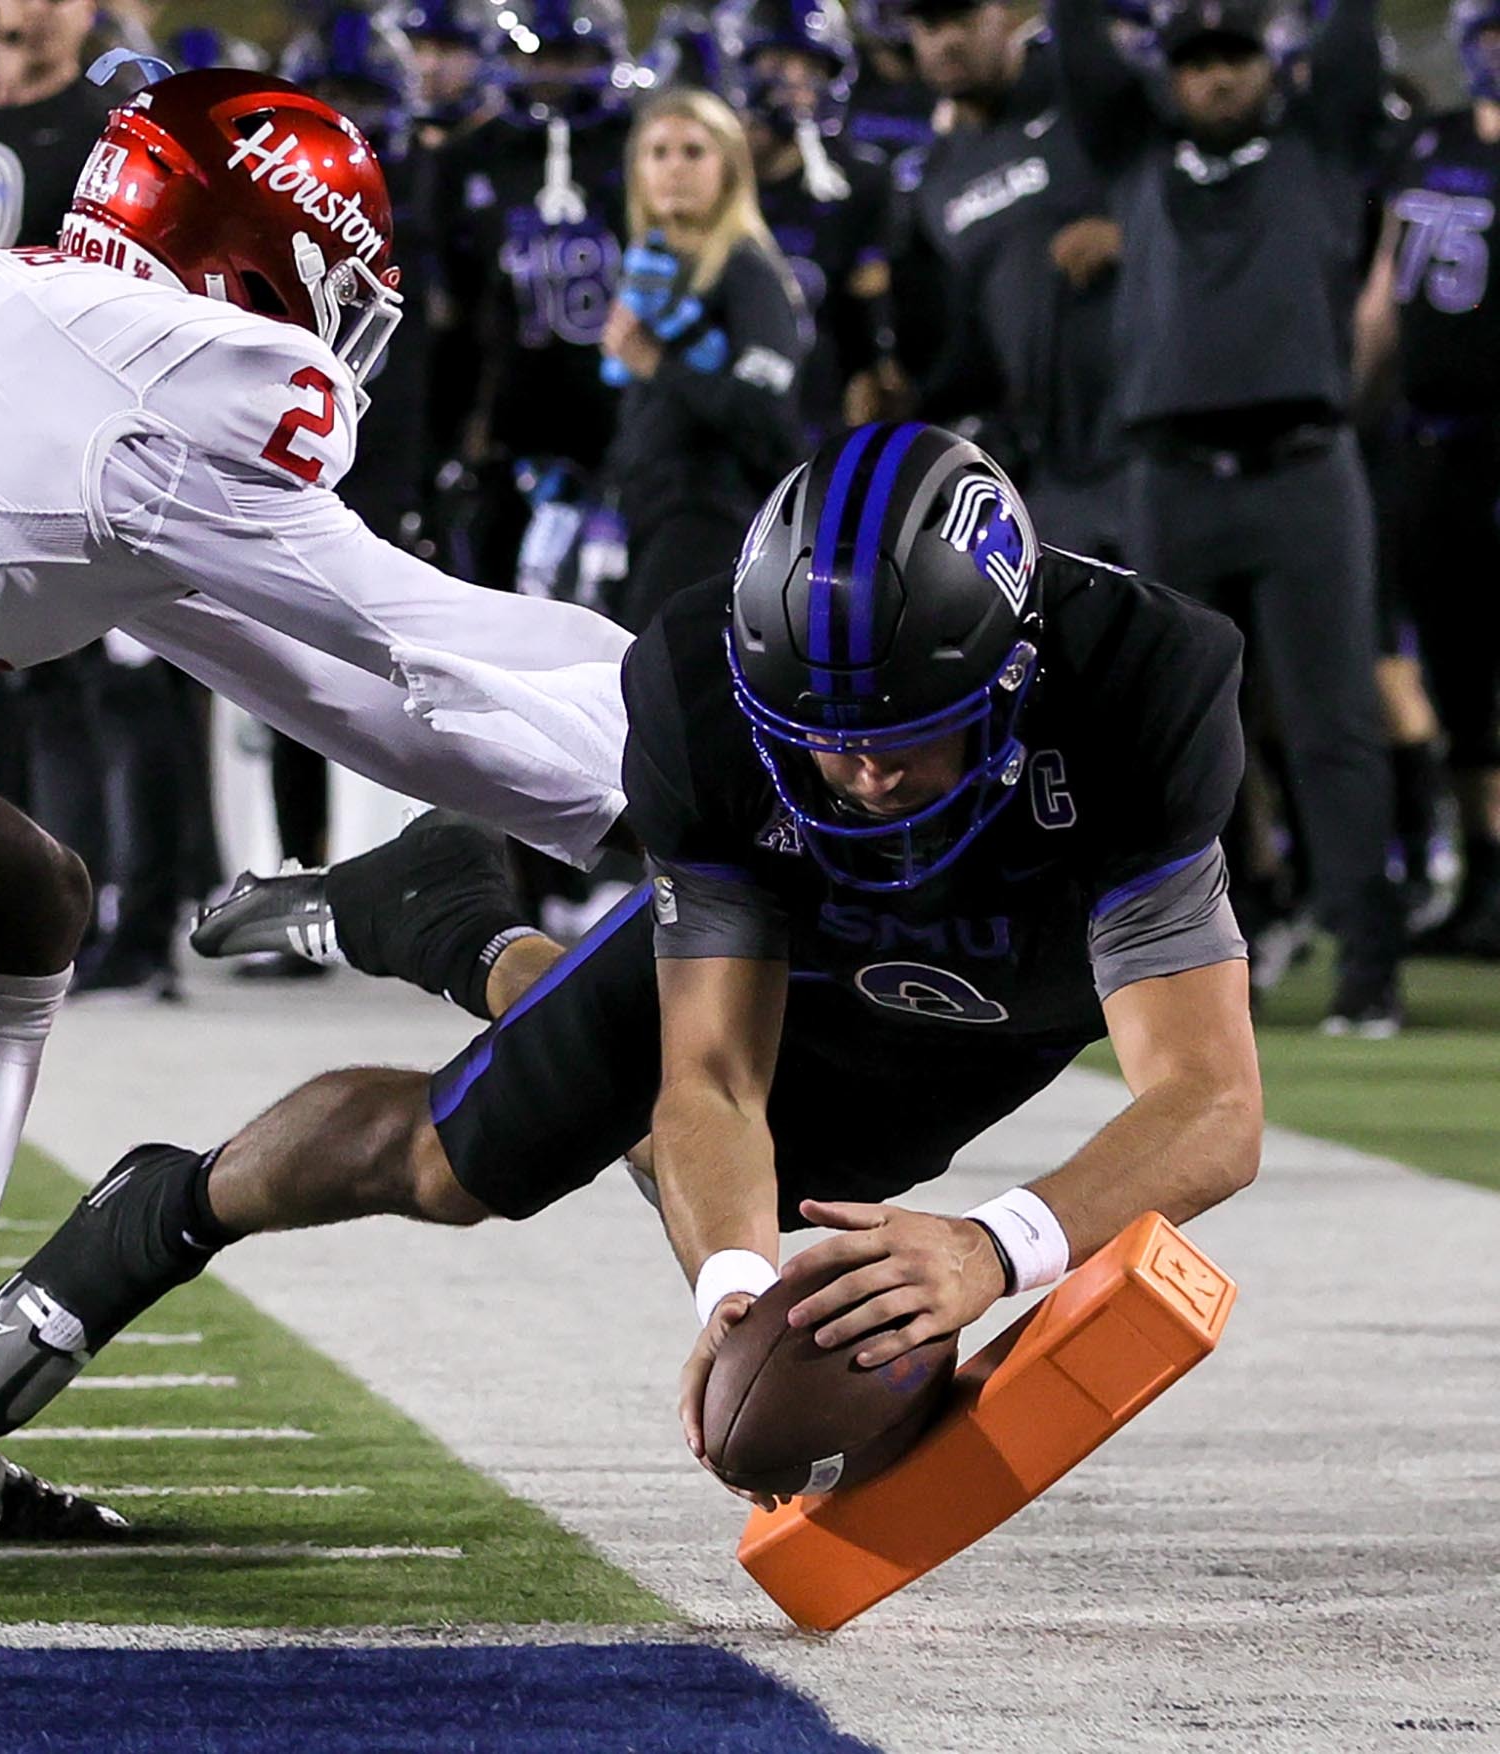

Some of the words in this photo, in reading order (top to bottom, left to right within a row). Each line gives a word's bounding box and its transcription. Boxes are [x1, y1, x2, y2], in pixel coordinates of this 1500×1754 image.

[227, 121, 386, 264] Houston
[500, 232, 621, 346] 18
[1392, 188, 1495, 314] 75
[261, 365, 335, 482] 2
[1028, 749, 1077, 830] C
[818, 901, 1012, 959] SMU
